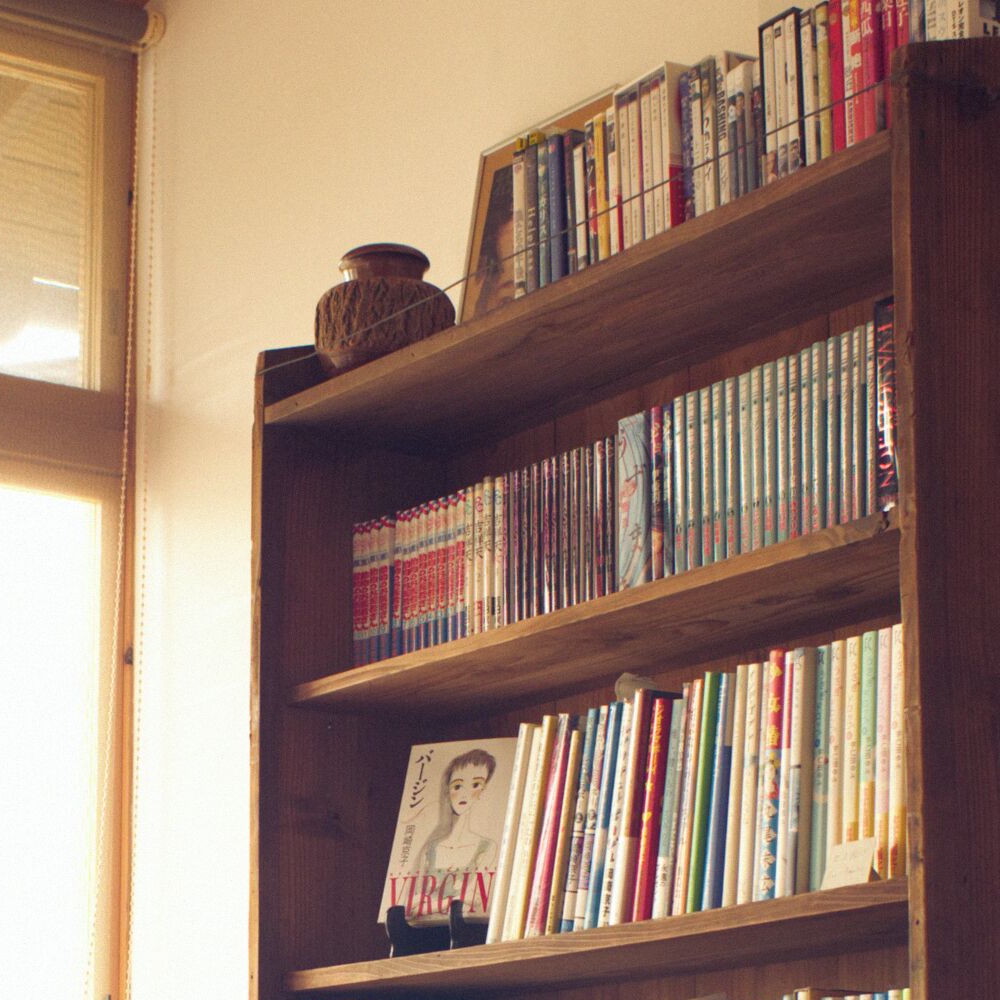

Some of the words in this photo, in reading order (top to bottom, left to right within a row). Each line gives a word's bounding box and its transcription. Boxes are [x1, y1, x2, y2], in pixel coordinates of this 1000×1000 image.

[410, 749, 434, 809] バージン
[390, 871, 497, 918] VIRGIN
